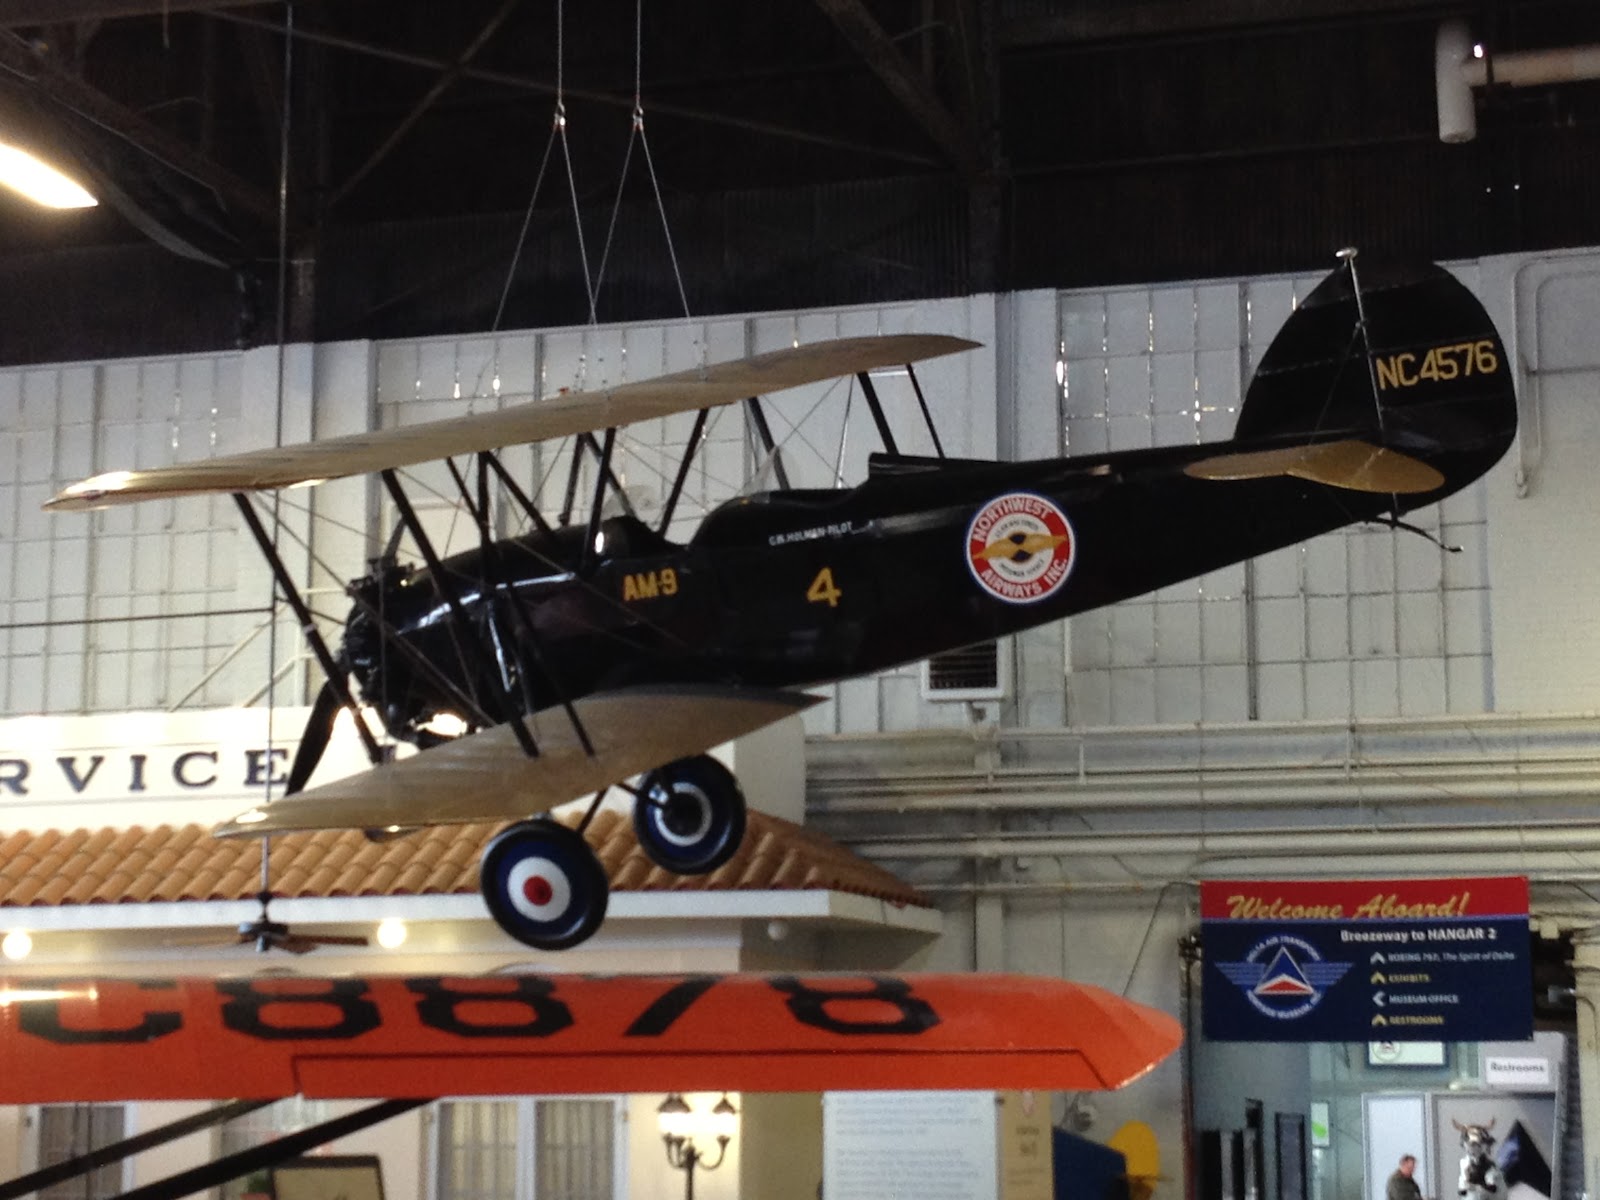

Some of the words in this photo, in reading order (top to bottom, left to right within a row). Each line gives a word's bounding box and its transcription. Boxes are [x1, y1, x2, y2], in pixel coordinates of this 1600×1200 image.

[1375, 340, 1498, 391] NC4576
[971, 497, 1053, 543] NORTHWEST
[806, 567, 842, 608] 4
[980, 569, 1042, 598] AIRWAYS
[1226, 894, 1344, 920] Welcome
[1352, 891, 1471, 921] Aboard!
[1340, 929, 1408, 943] Breezeway
[1411, 929, 1425, 941] to
[1427, 927, 1485, 941] HANGAR
[1487, 927, 1497, 940] 2
[1490, 1061, 1545, 1073] Restrooms
